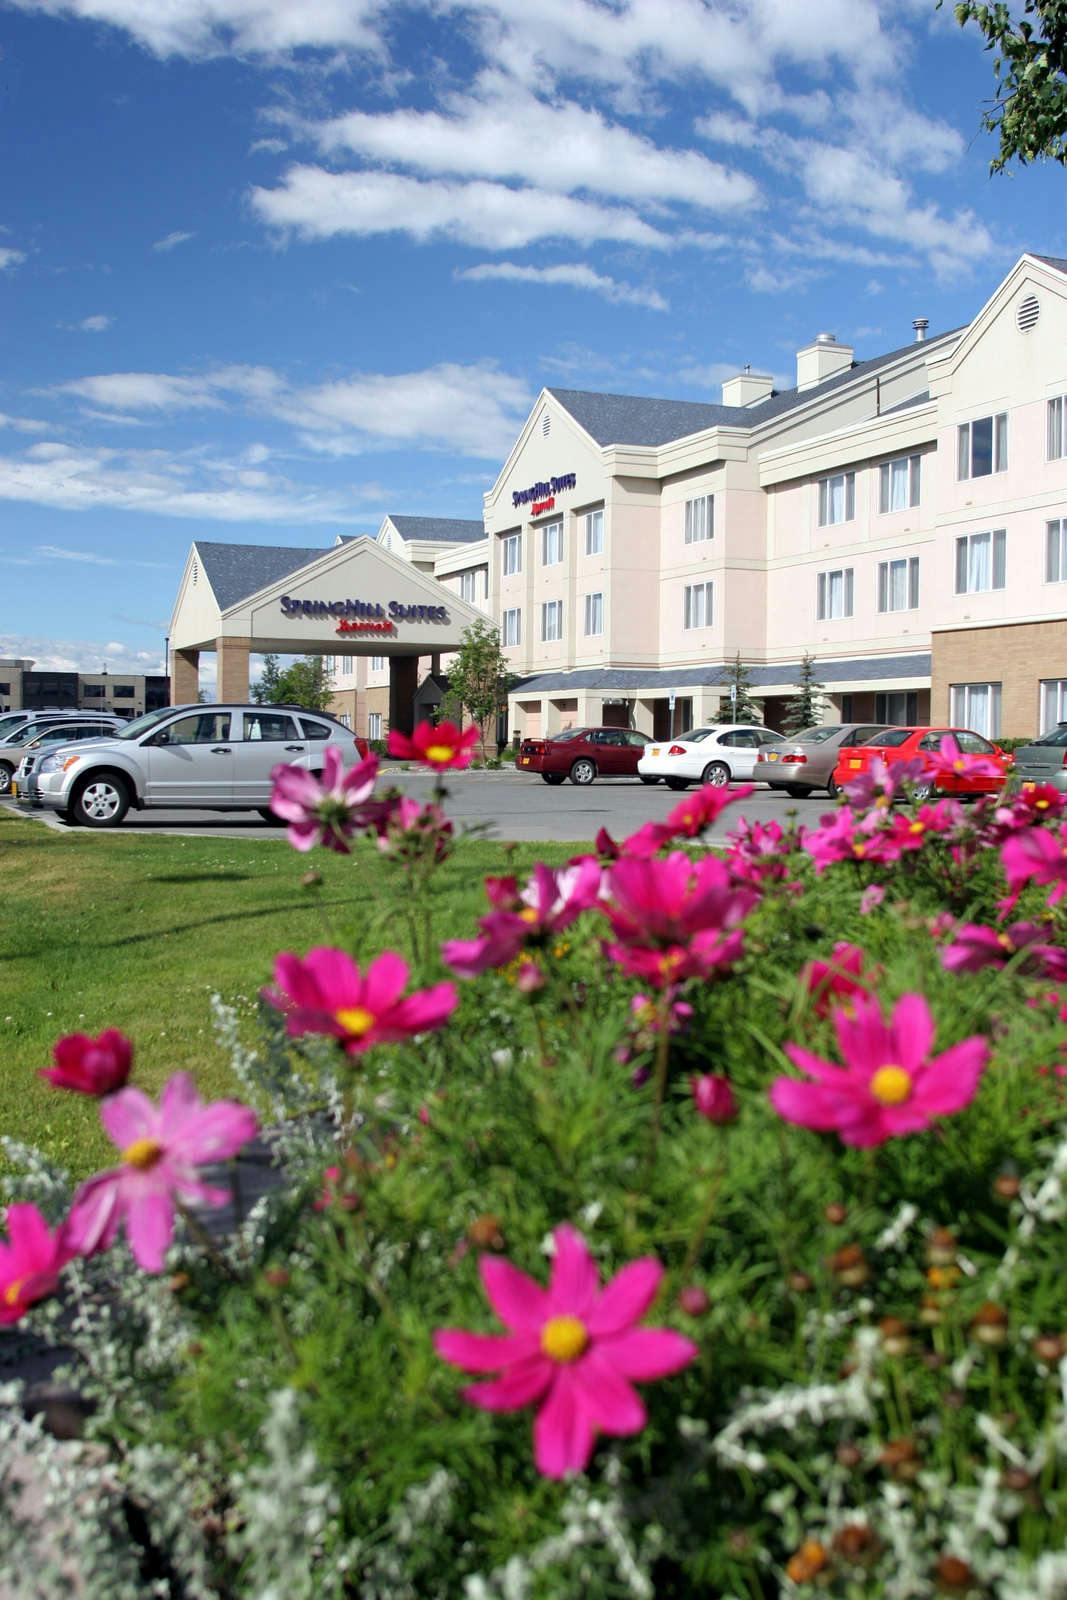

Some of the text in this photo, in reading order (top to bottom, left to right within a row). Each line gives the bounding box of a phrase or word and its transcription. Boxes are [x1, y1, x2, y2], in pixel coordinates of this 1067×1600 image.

[280, 596, 446, 620] SPRINGHILL SUITES
[336, 619, 393, 634] Marriott
